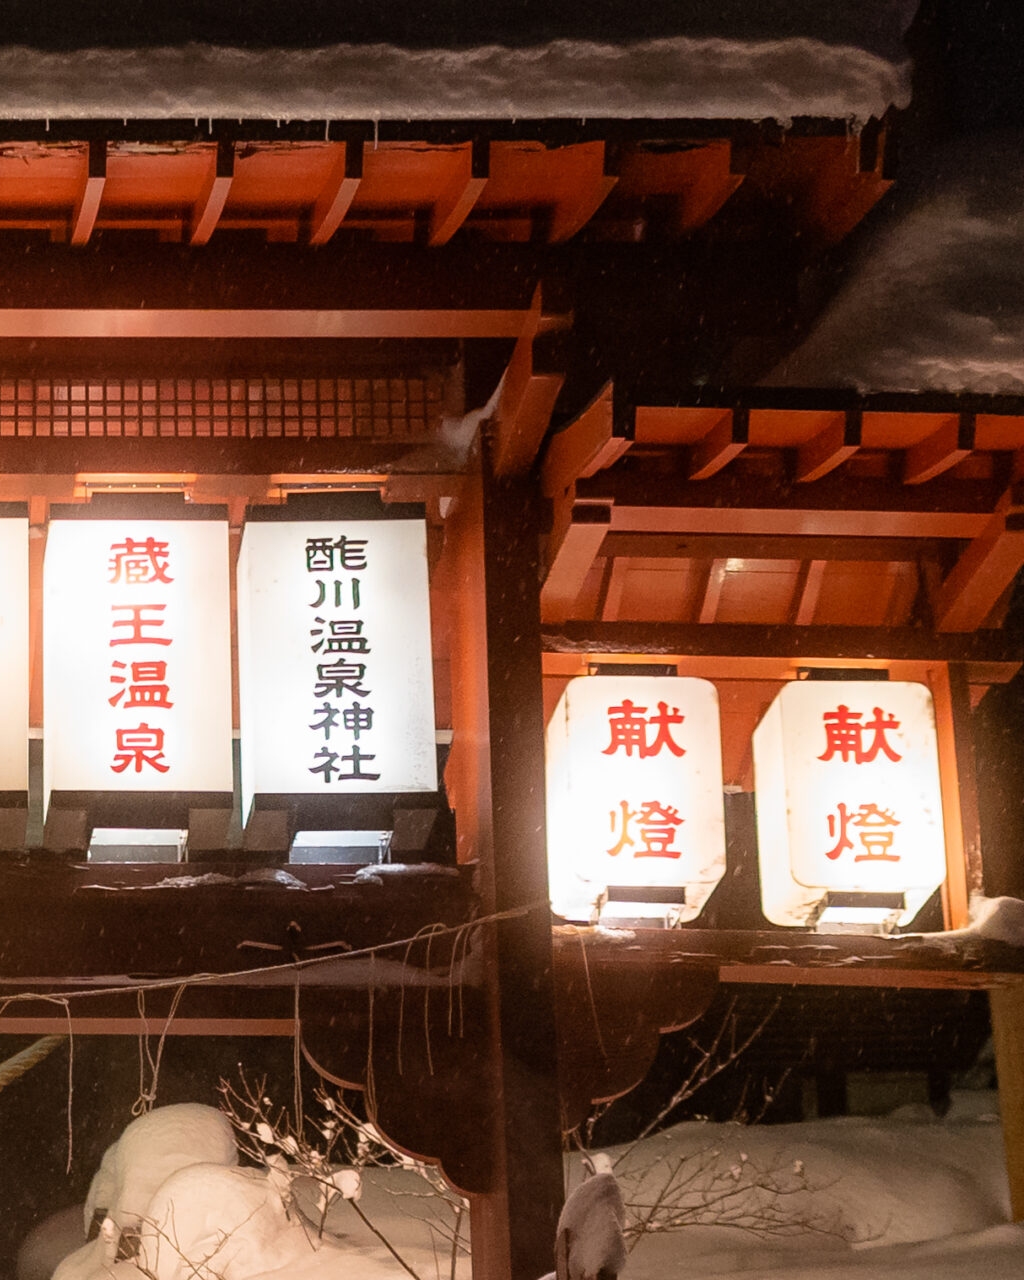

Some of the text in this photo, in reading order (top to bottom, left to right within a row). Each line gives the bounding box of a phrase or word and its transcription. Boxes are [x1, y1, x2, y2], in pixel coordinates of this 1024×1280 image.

[108, 537, 174, 774] 蔵王温泉
[602, 699, 687, 859] 献燈
[817, 704, 902, 862] 献燈
